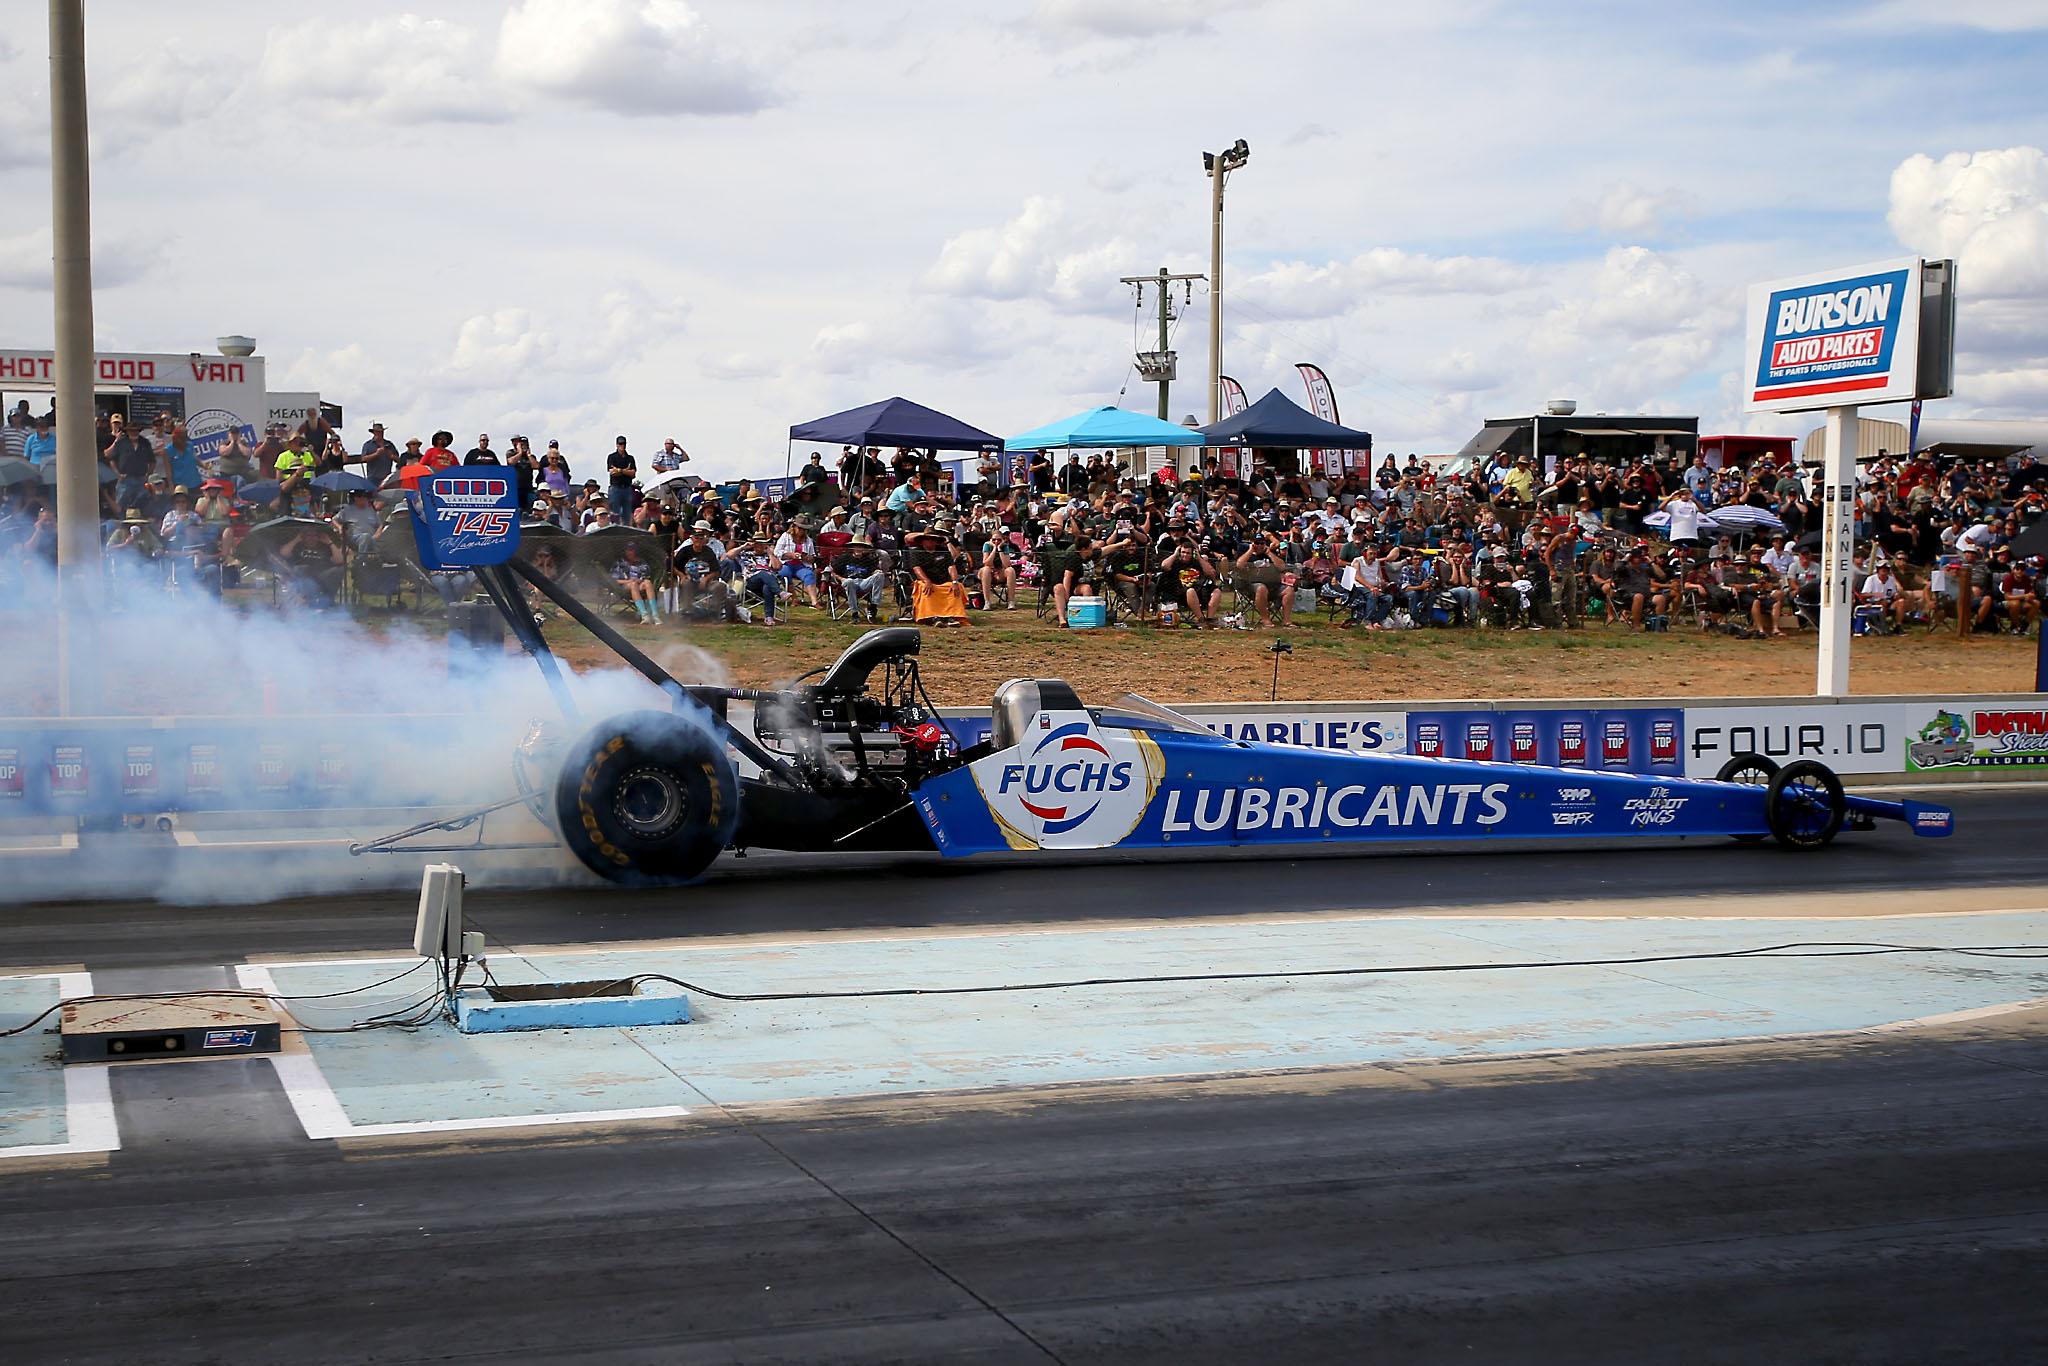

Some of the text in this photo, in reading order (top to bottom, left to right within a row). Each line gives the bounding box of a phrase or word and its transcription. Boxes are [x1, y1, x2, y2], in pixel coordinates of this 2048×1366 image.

[1775, 283, 1893, 336] BURSON
[1777, 331, 1875, 365] AUTO PARTS
[0, 357, 244, 383] HOT OOD VAN
[1769, 357, 1879, 378] THE PARTS PROFESSIONALS
[269, 408, 306, 419] MEAT
[437, 481, 504, 495] LTFR
[453, 512, 514, 537] 145
[1825, 504, 1833, 571] LANE
[1840, 504, 1850, 571] LANE
[1825, 576, 1832, 604] 1
[1840, 576, 1847, 604] 1
[922, 727, 935, 739] MSD
[1206, 721, 1384, 750] HARLIE'S
[1692, 723, 1885, 758] FOUR.IO
[1420, 740, 1438, 752] TOP
[1470, 740, 1488, 751] TOP
[1514, 739, 1533, 750] TOP
[1563, 738, 1581, 749] TOP
[1607, 737, 1624, 748] TOP
[1655, 737, 1671, 748] TOP
[191, 761, 216, 775] TOP
[1971, 756, 2046, 765] MILDURA
[0, 765, 16, 780] OP
[56, 764, 81, 778] TOP
[128, 762, 152, 777] TOP
[998, 762, 1132, 794] FUCHS
[1650, 786, 1670, 797] THE
[1161, 783, 1510, 832] LUBRICANTS
[1630, 809, 1676, 826] KINGS
[1916, 812, 1950, 821] BURSON
